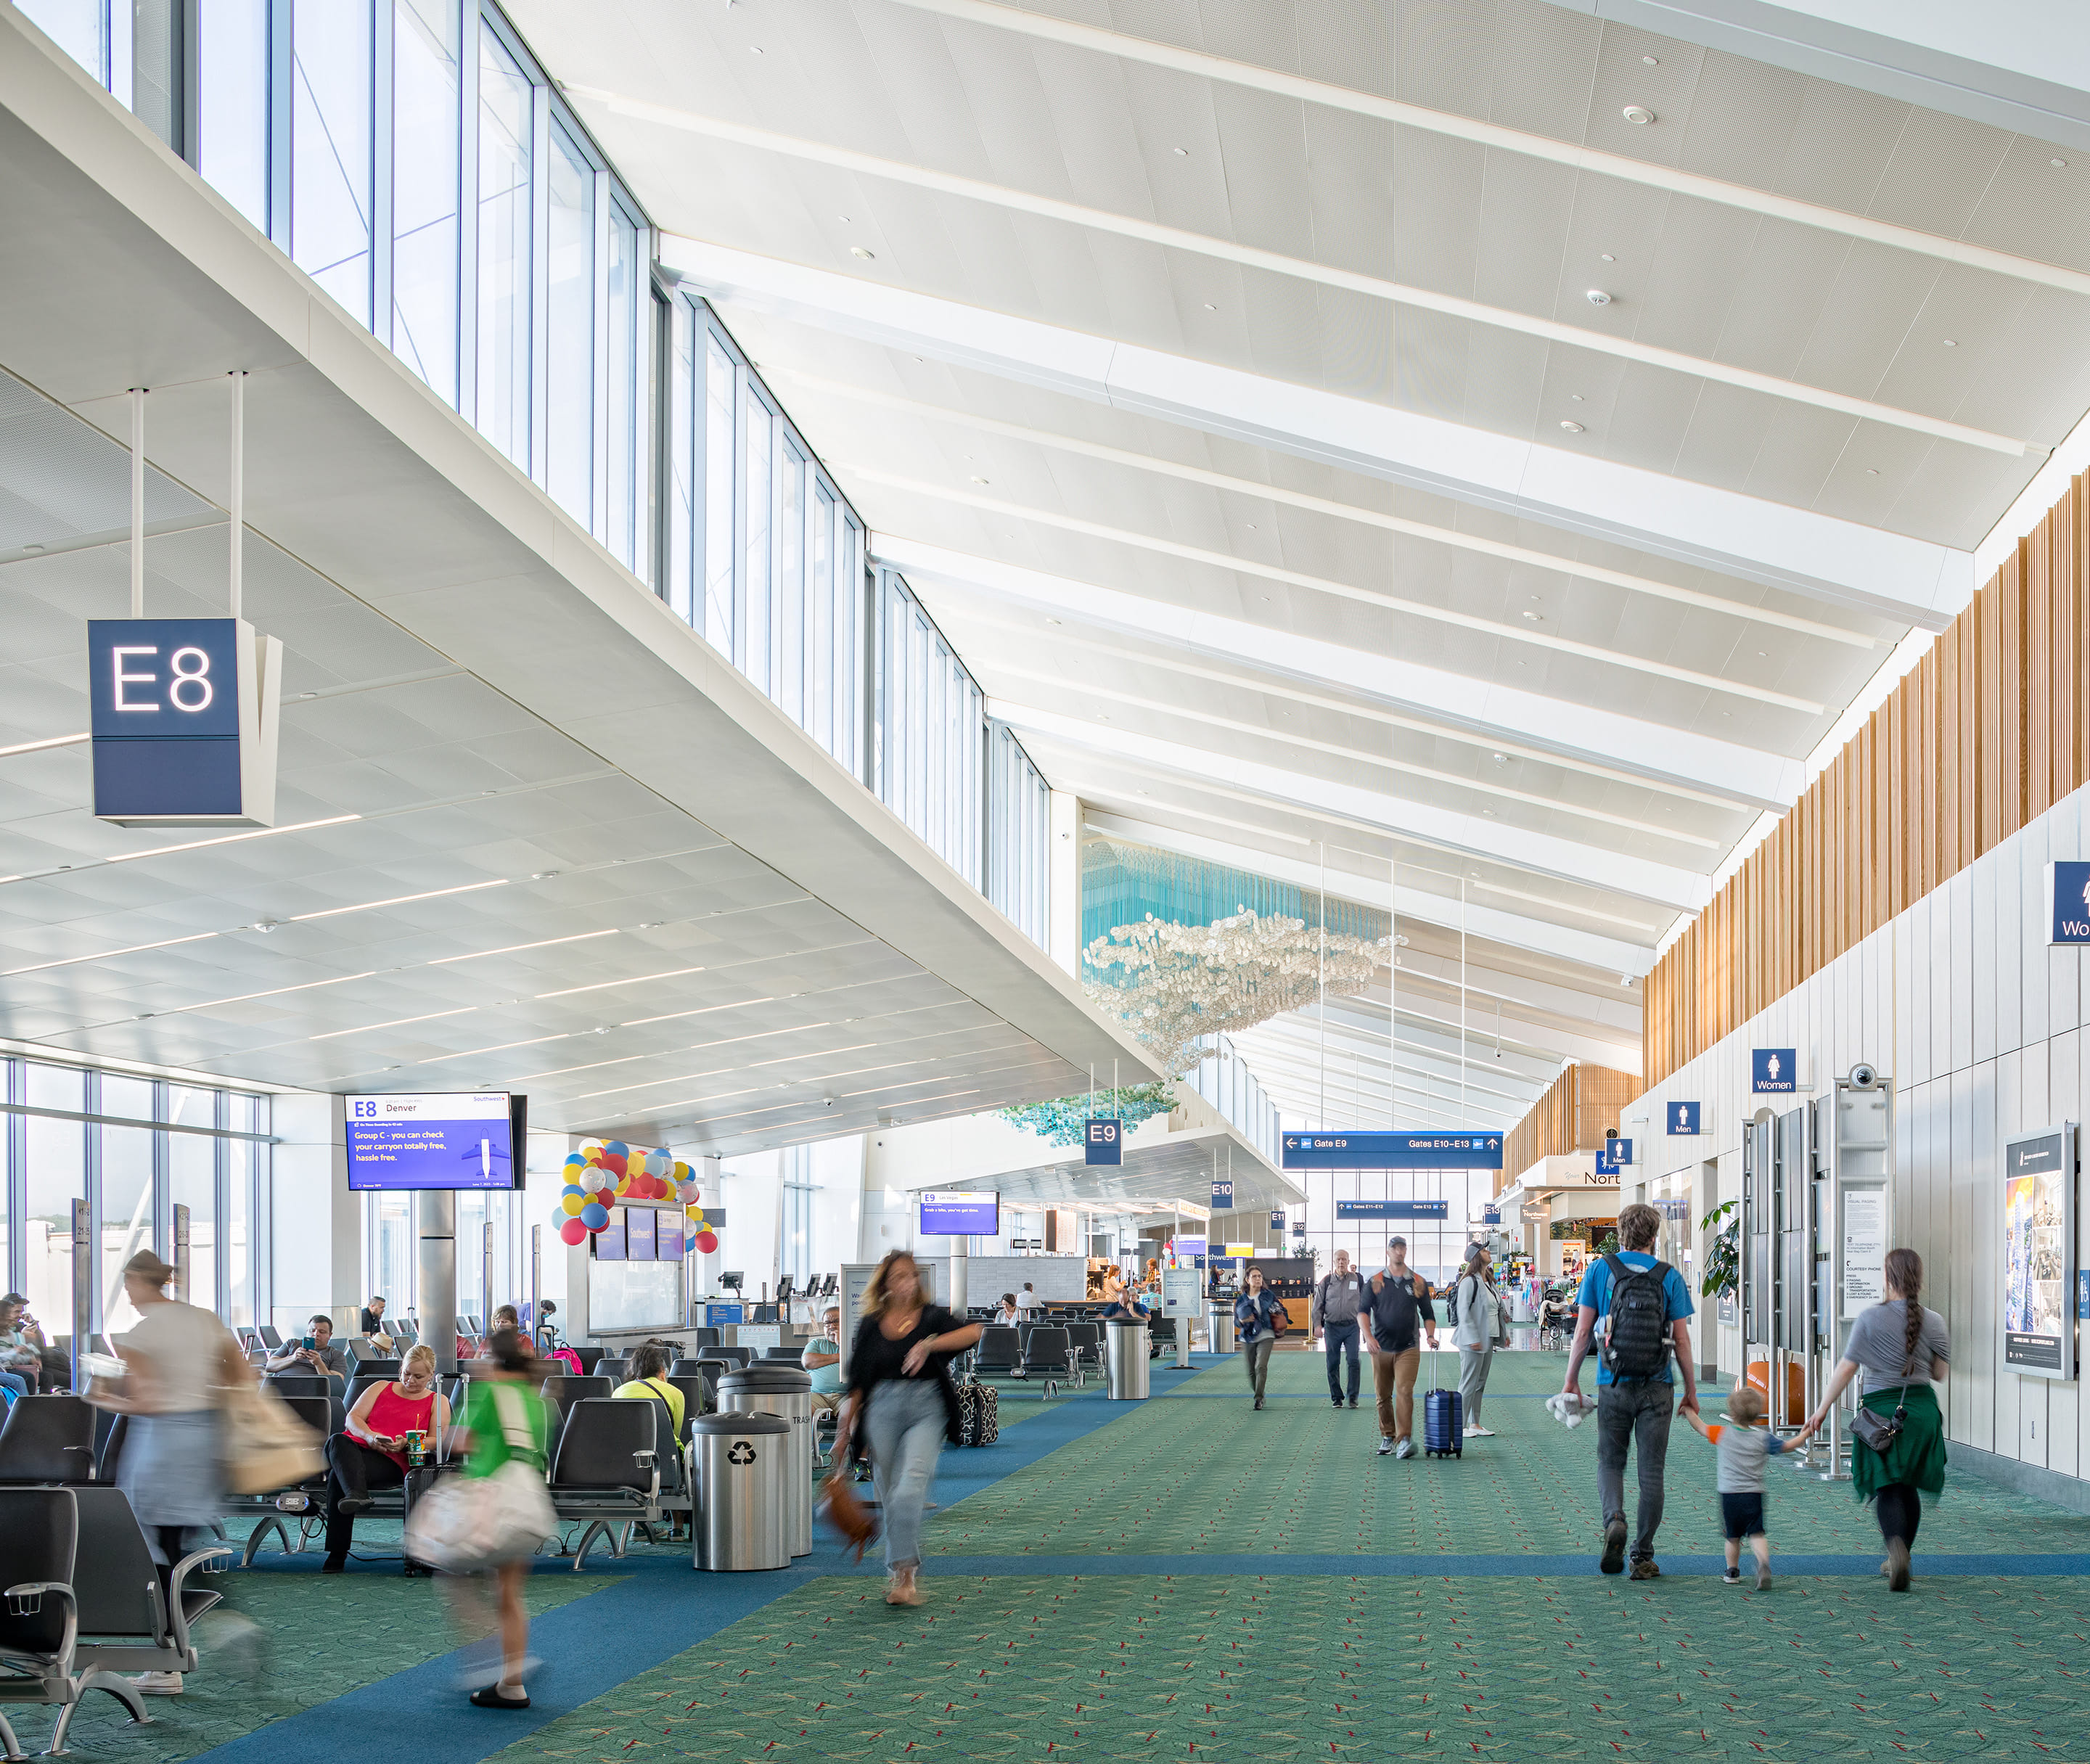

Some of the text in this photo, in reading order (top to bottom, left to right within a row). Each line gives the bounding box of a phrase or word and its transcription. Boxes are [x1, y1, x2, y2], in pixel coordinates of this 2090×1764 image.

[112, 645, 213, 713] E8
[1757, 1080, 1792, 1090] Women
[355, 1101, 377, 1117] E8
[1091, 1125, 1115, 1141] E9
[404, 1142, 428, 1151] totally
[1314, 1139, 1333, 1148] Gate
[1409, 1139, 1432, 1148] Gates
[1212, 1184, 1232, 1194] E10
